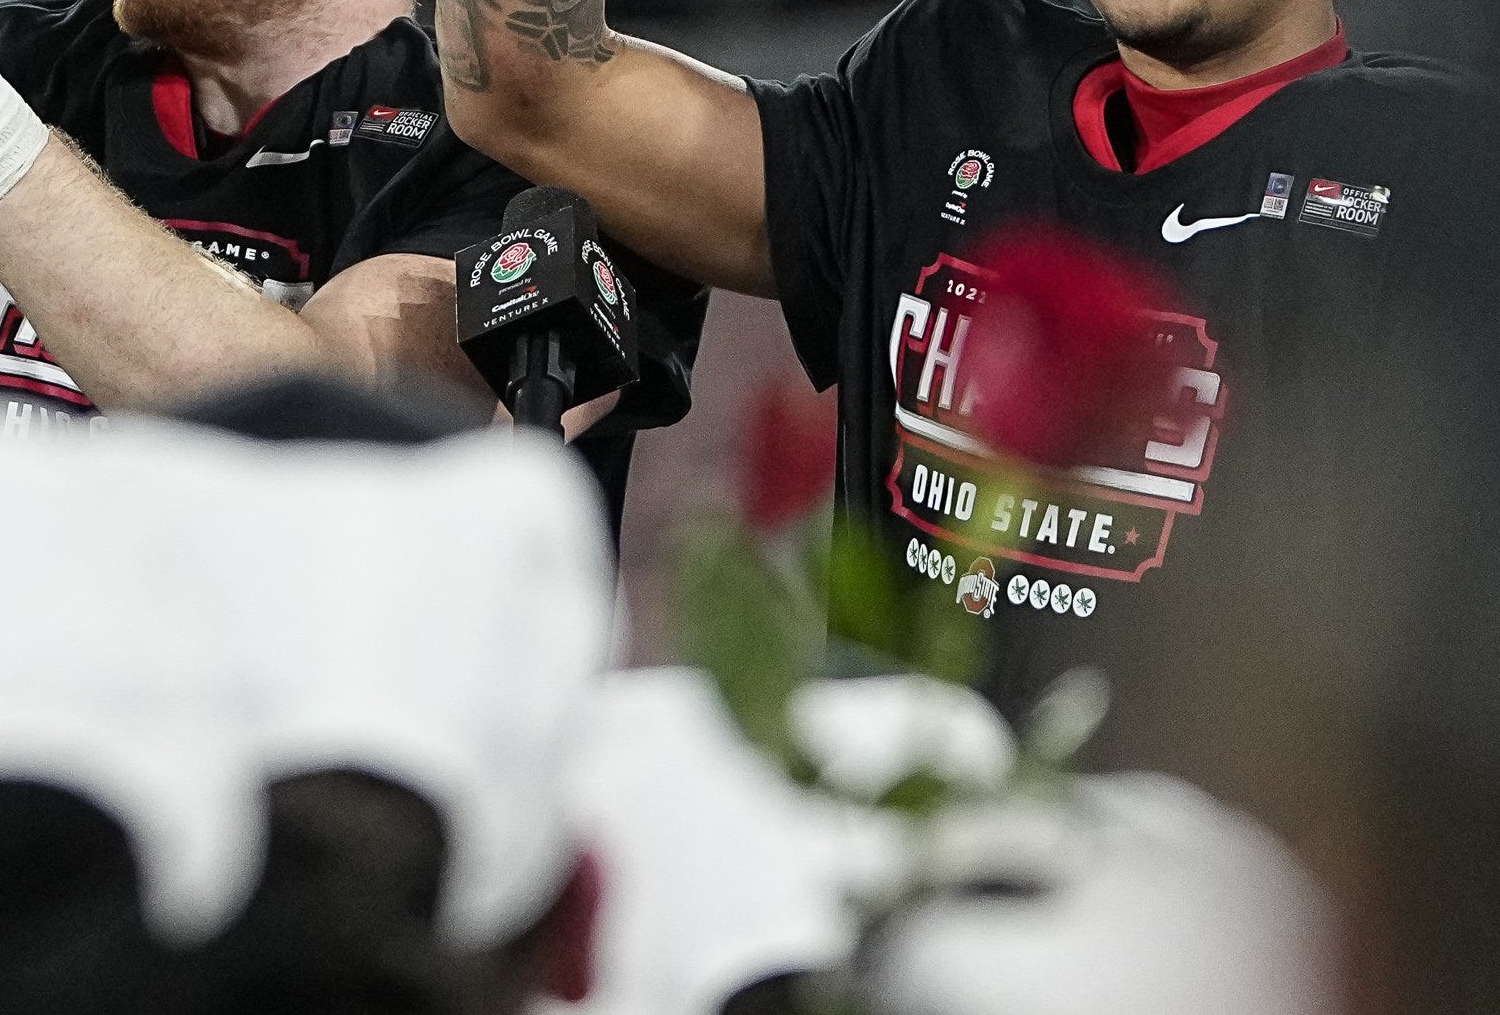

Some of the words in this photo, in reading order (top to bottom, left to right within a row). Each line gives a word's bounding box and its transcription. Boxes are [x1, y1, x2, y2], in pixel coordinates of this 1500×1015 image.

[393, 116, 431, 130] LOCKER
[398, 111, 433, 122] OFFICIAL
[386, 123, 426, 140] ROOM
[947, 151, 967, 176] ROSE
[967, 149, 991, 164] BOWL
[980, 162, 996, 188] GAME
[1342, 195, 1381, 212] LOCKER
[1343, 187, 1375, 201] OFFICI
[1336, 206, 1380, 226] ROOM
[469, 252, 492, 288] ROSE
[490, 228, 533, 252] BOWL
[533, 229, 559, 256] GAME
[483, 301, 539, 328] VENTURE
[541, 297, 549, 305] X
[889, 292, 1221, 469] CHS
[912, 464, 977, 521] OHIO
